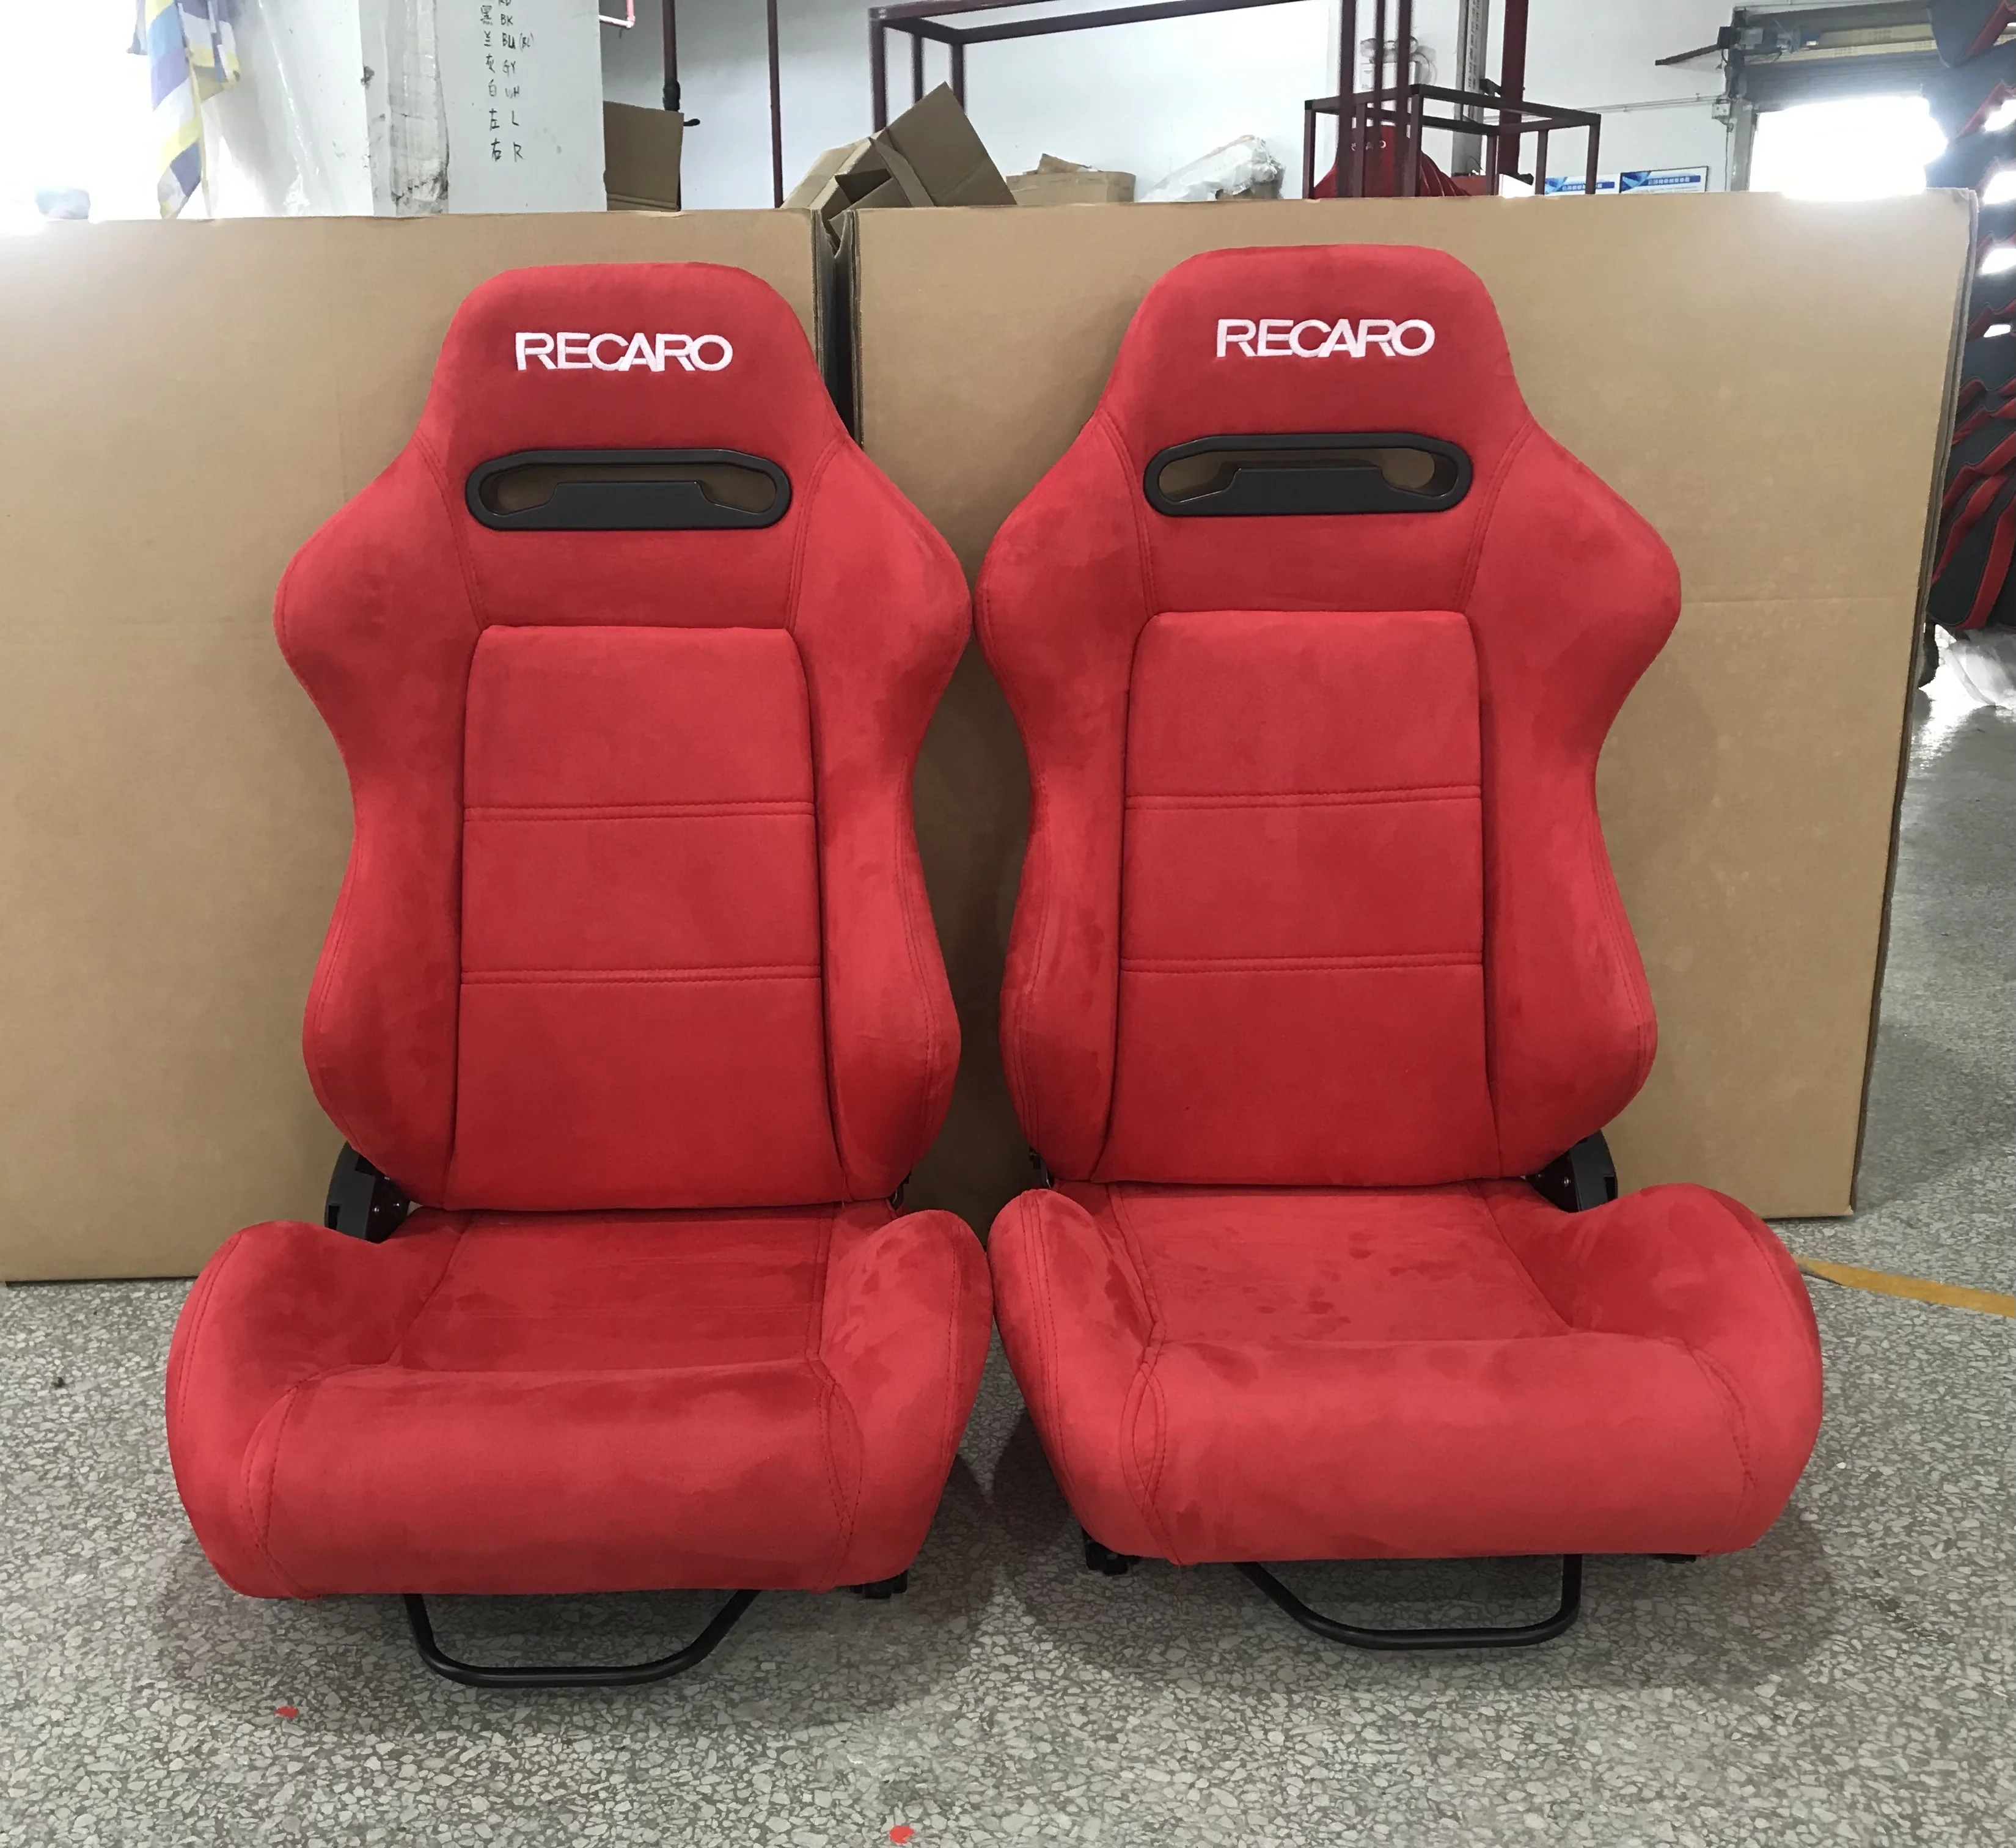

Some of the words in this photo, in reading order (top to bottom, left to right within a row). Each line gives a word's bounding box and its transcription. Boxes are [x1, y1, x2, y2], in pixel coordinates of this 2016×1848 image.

[500, 13, 513, 26] BK
[502, 32, 516, 49] BU
[502, 59, 516, 77] GY
[488, 79, 497, 97] 白
[489, 108, 500, 131] 左
[511, 110, 519, 126] L
[491, 138, 501, 162] 右
[513, 141, 524, 163] R
[1217, 318, 1435, 358] RECARO
[515, 332, 733, 372] RECARO
